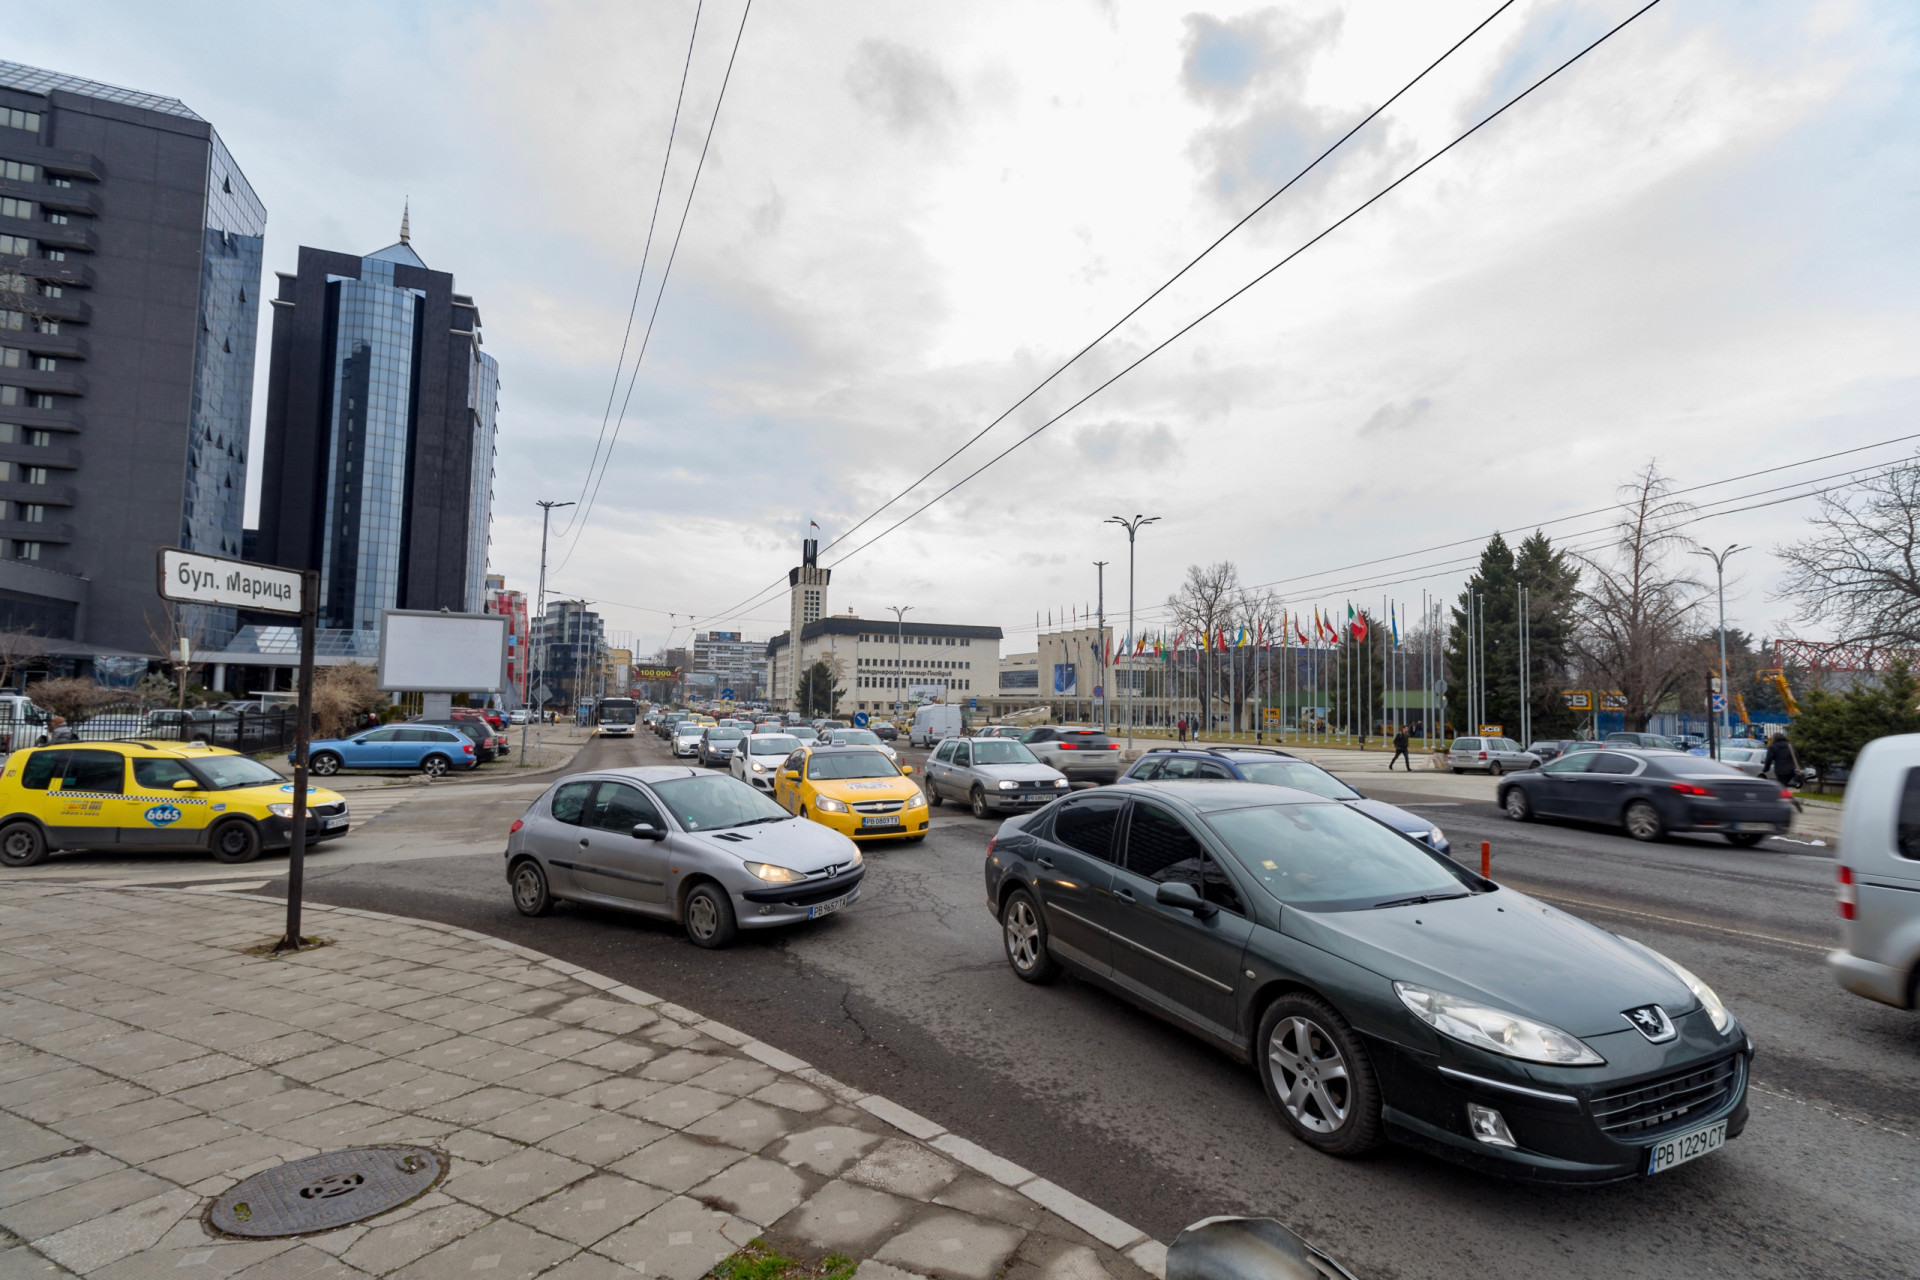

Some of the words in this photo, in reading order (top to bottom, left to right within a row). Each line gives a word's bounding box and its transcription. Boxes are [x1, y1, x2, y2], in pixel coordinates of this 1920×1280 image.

[178, 562, 219, 592] бул.
[226, 571, 292, 602] Марица
[640, 669, 655, 677] 100
[147, 809, 179, 820] 6665
[866, 817, 875, 825] PB
[814, 905, 823, 917] PB
[823, 900, 838, 913] 9657
[1656, 1143, 1674, 1168] PB
[1678, 1131, 1707, 1160] 1229
[1709, 1124, 1725, 1147] CT
